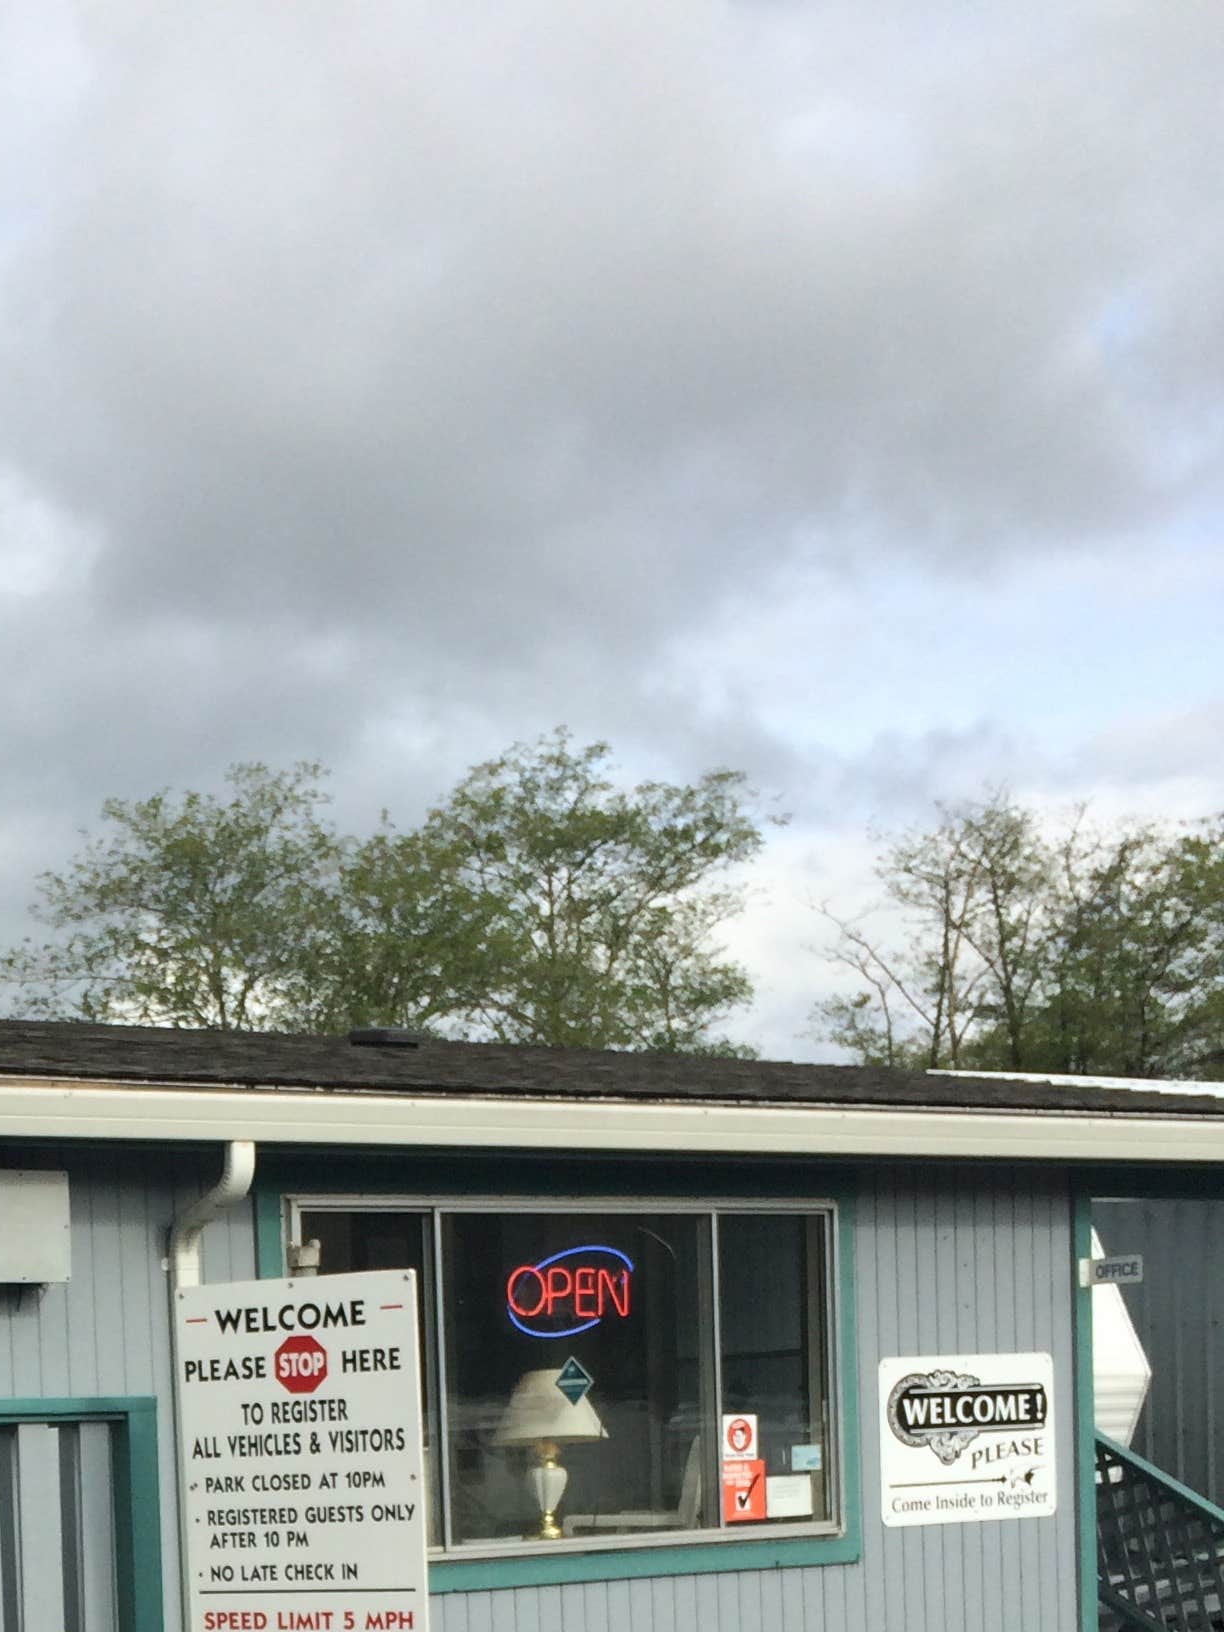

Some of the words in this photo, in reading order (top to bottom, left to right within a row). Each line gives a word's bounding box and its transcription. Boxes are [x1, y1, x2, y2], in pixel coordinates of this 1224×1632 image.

[1096, 1262, 1139, 1278] OFFICE
[507, 1266, 629, 1317] OPEN
[214, 1299, 366, 1335] WELCOME
[184, 1356, 267, 1383] PLEASE
[279, 1351, 325, 1378] STOP
[341, 1347, 401, 1373] HERE
[241, 1402, 264, 1426] TO
[271, 1398, 348, 1424] REGISTER
[192, 1436, 221, 1459] ALL
[227, 1432, 302, 1457] VEHICLES
[309, 1432, 321, 1455] &
[328, 1427, 405, 1453] VISITORS
[970, 1437, 1045, 1469] PLEASE
[205, 1476, 245, 1493] PARK
[251, 1473, 312, 1492] CLOSED
[319, 1472, 338, 1489] AT
[345, 1471, 386, 1489] 10PM
[891, 1496, 933, 1513] Come
[936, 1494, 975, 1509] Inside
[980, 1492, 993, 1507] to
[997, 1490, 1048, 1510] Register
[207, 1507, 298, 1526] REGISTERED
[304, 1505, 364, 1524] GUESTS
[371, 1503, 415, 1522] ONLY
[210, 1531, 257, 1549] AFTER
[264, 1530, 280, 1548] 10
[286, 1530, 309, 1547] PM
[210, 1565, 234, 1582] NO
[241, 1564, 278, 1582] LATE
[284, 1563, 335, 1582] CHECK
[341, 1563, 358, 1580] IN
[204, 1611, 268, 1631] SPEED
[277, 1611, 334, 1631] LIMIT
[343, 1611, 355, 1630] 5
[365, 1611, 413, 1630] MPH
